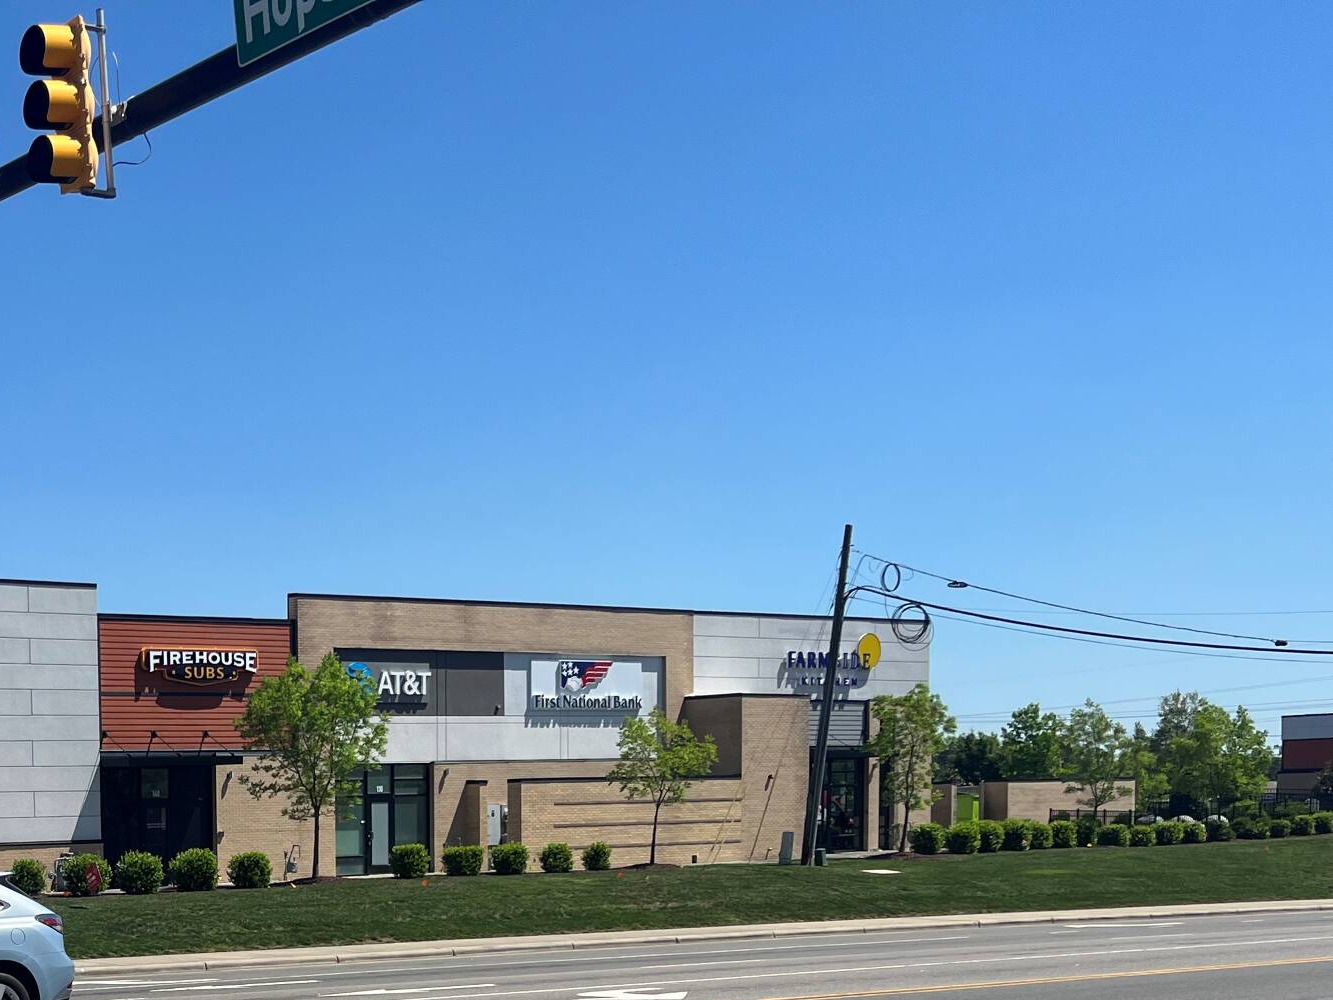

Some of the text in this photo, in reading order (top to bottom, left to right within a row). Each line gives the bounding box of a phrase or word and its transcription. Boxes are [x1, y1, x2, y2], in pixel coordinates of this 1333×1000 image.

[243, 0, 333, 43] Hop
[149, 650, 258, 674] FIREHOUSE
[787, 651, 871, 670] FARMIDE
[185, 666, 224, 679] SUBS
[802, 677, 858, 687] KITHEN
[378, 670, 432, 695] AT&T
[534, 694, 643, 709] First National Bank
